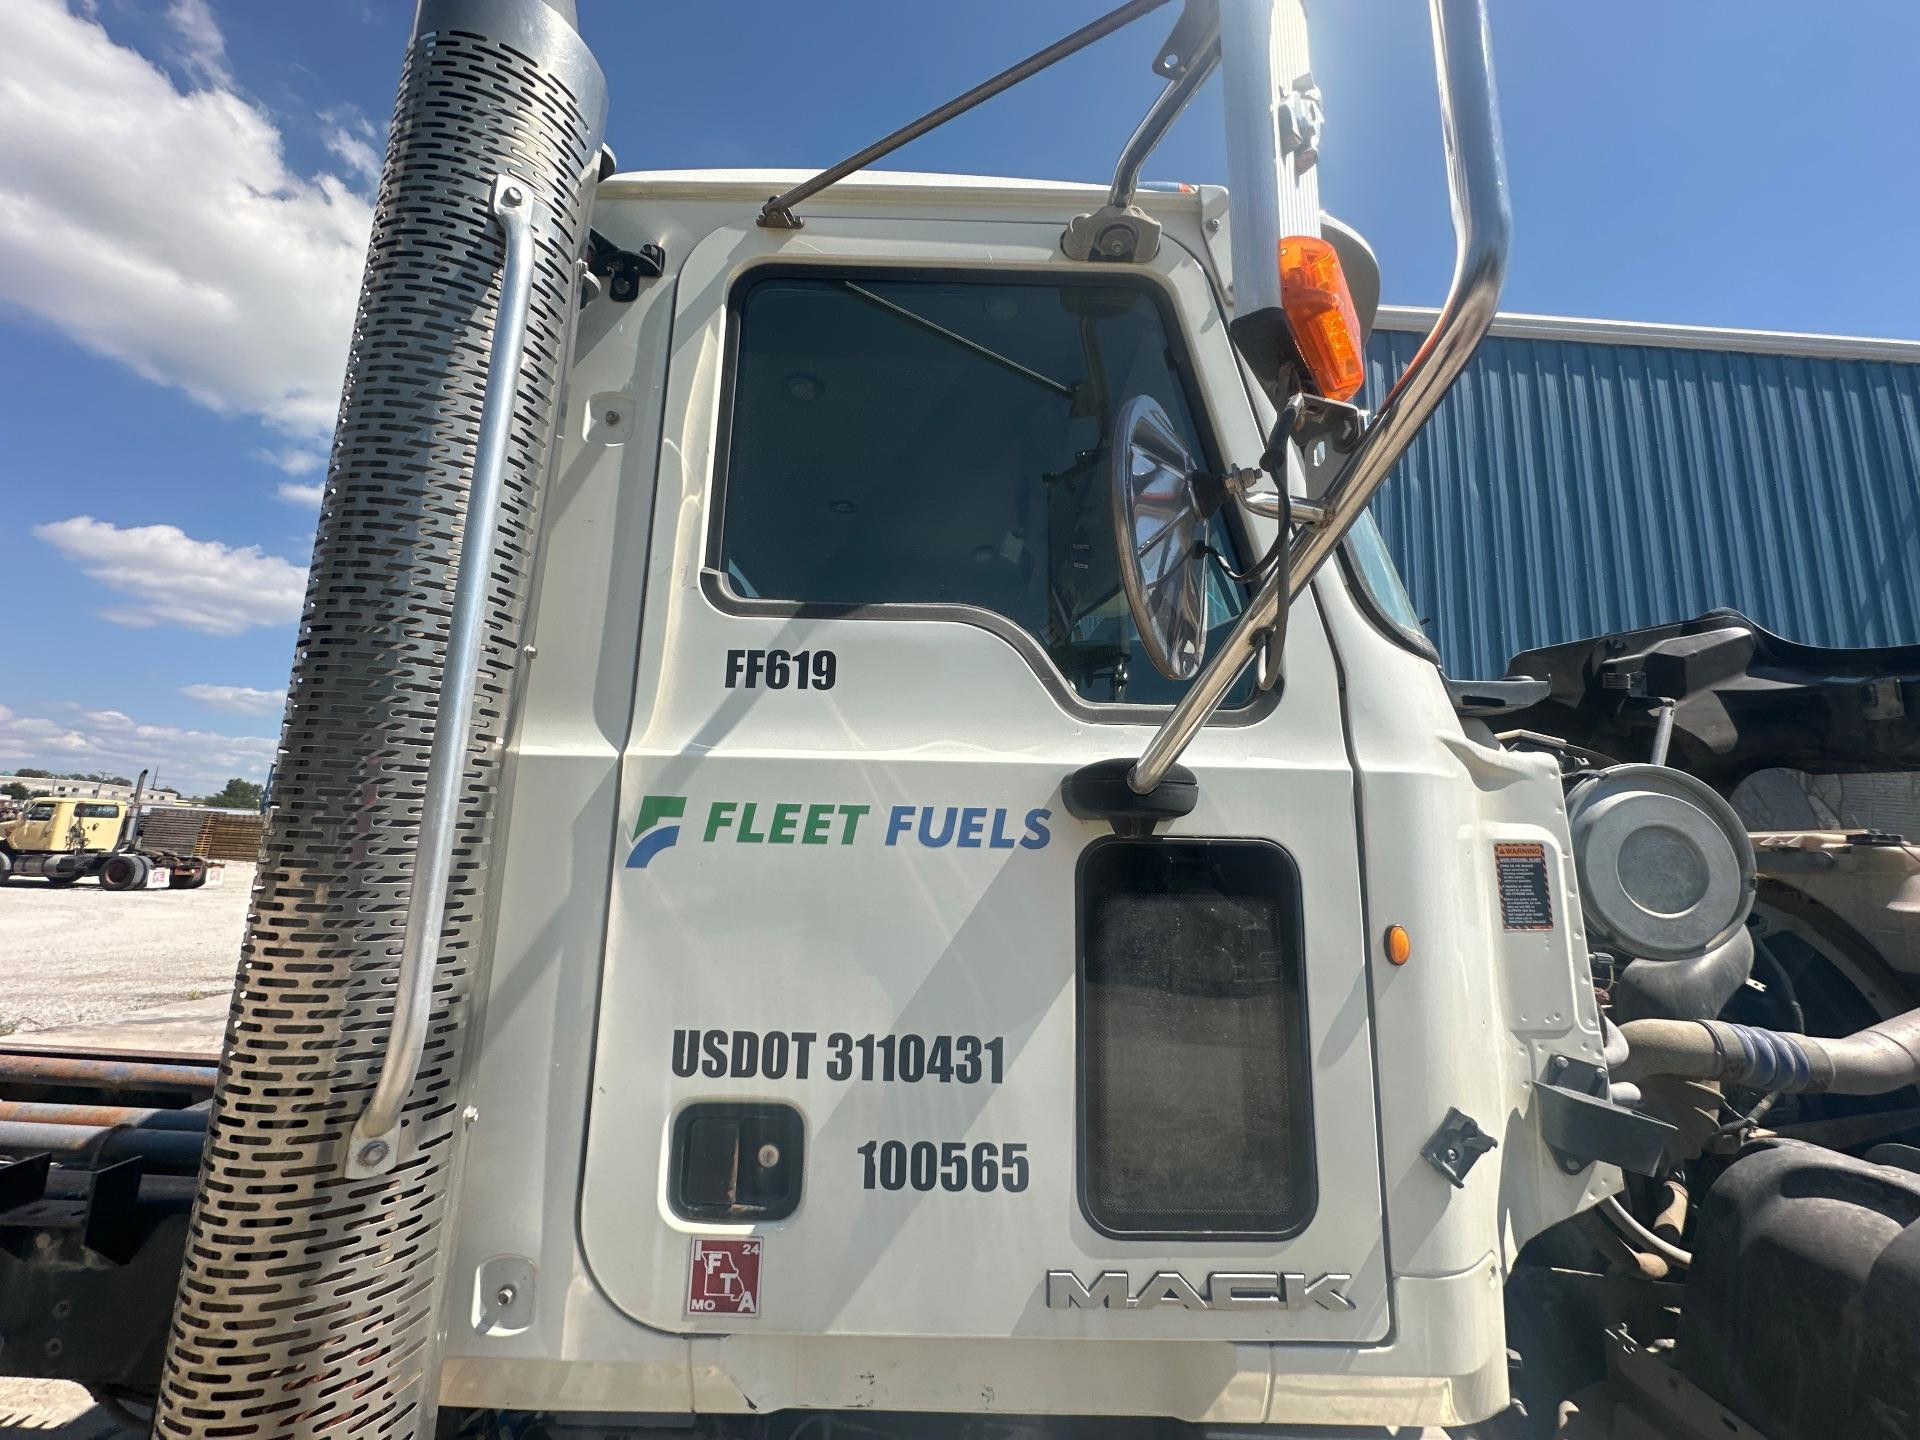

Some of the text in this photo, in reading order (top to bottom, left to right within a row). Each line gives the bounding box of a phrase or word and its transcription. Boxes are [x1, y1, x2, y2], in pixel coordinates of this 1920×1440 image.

[725, 650, 836, 690] FF619
[703, 802, 1051, 849] FLEET FUELS
[1505, 847, 1541, 855] WARNING
[672, 1030, 1003, 1084] USDOT 3110431
[857, 1140, 1030, 1193] 100565
[742, 1244, 759, 1255] 24
[691, 1299, 715, 1310] MO
[1047, 1269, 1356, 1310] MACK
